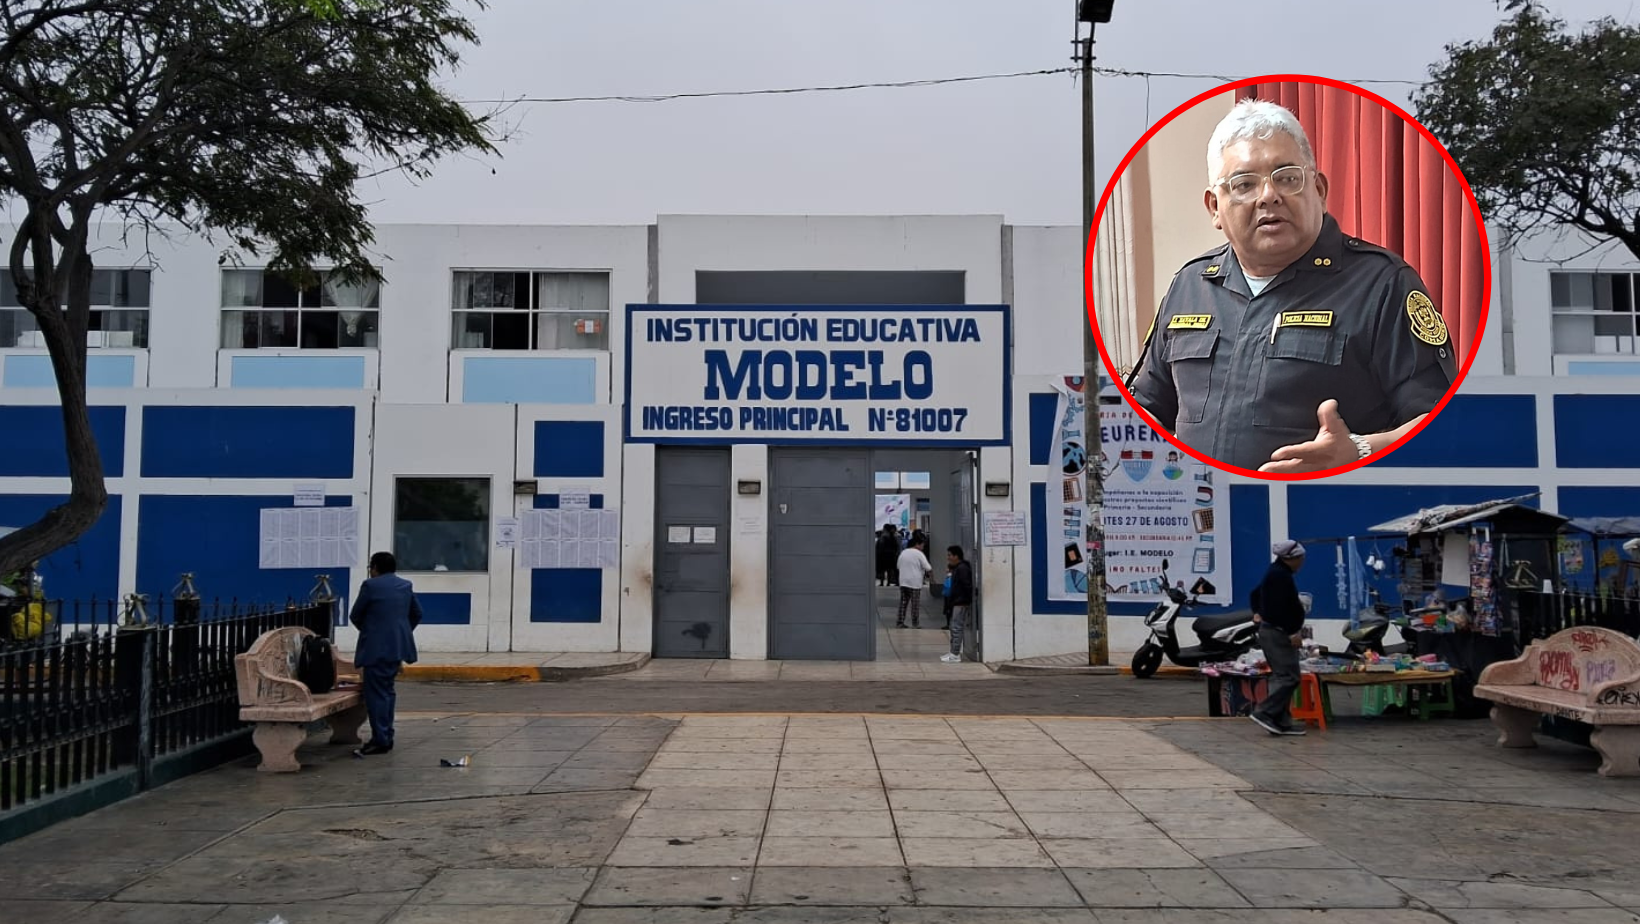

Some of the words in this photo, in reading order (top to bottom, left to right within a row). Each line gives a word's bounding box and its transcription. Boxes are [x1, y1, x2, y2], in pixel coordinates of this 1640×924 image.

[646, 313, 818, 343] INSTITUCIÓN
[826, 318, 981, 342] EDUCATIVA
[703, 349, 934, 400] MODELO
[642, 406, 734, 431] INGRESO
[739, 407, 849, 432] PRINCIPAL
[1100, 424, 1170, 444] EUREK
[1125, 516, 1137, 526] 27
[1140, 516, 1152, 526] DE
[1154, 516, 1189, 526] AGOSTO
[1140, 549, 1174, 557] MODELO
